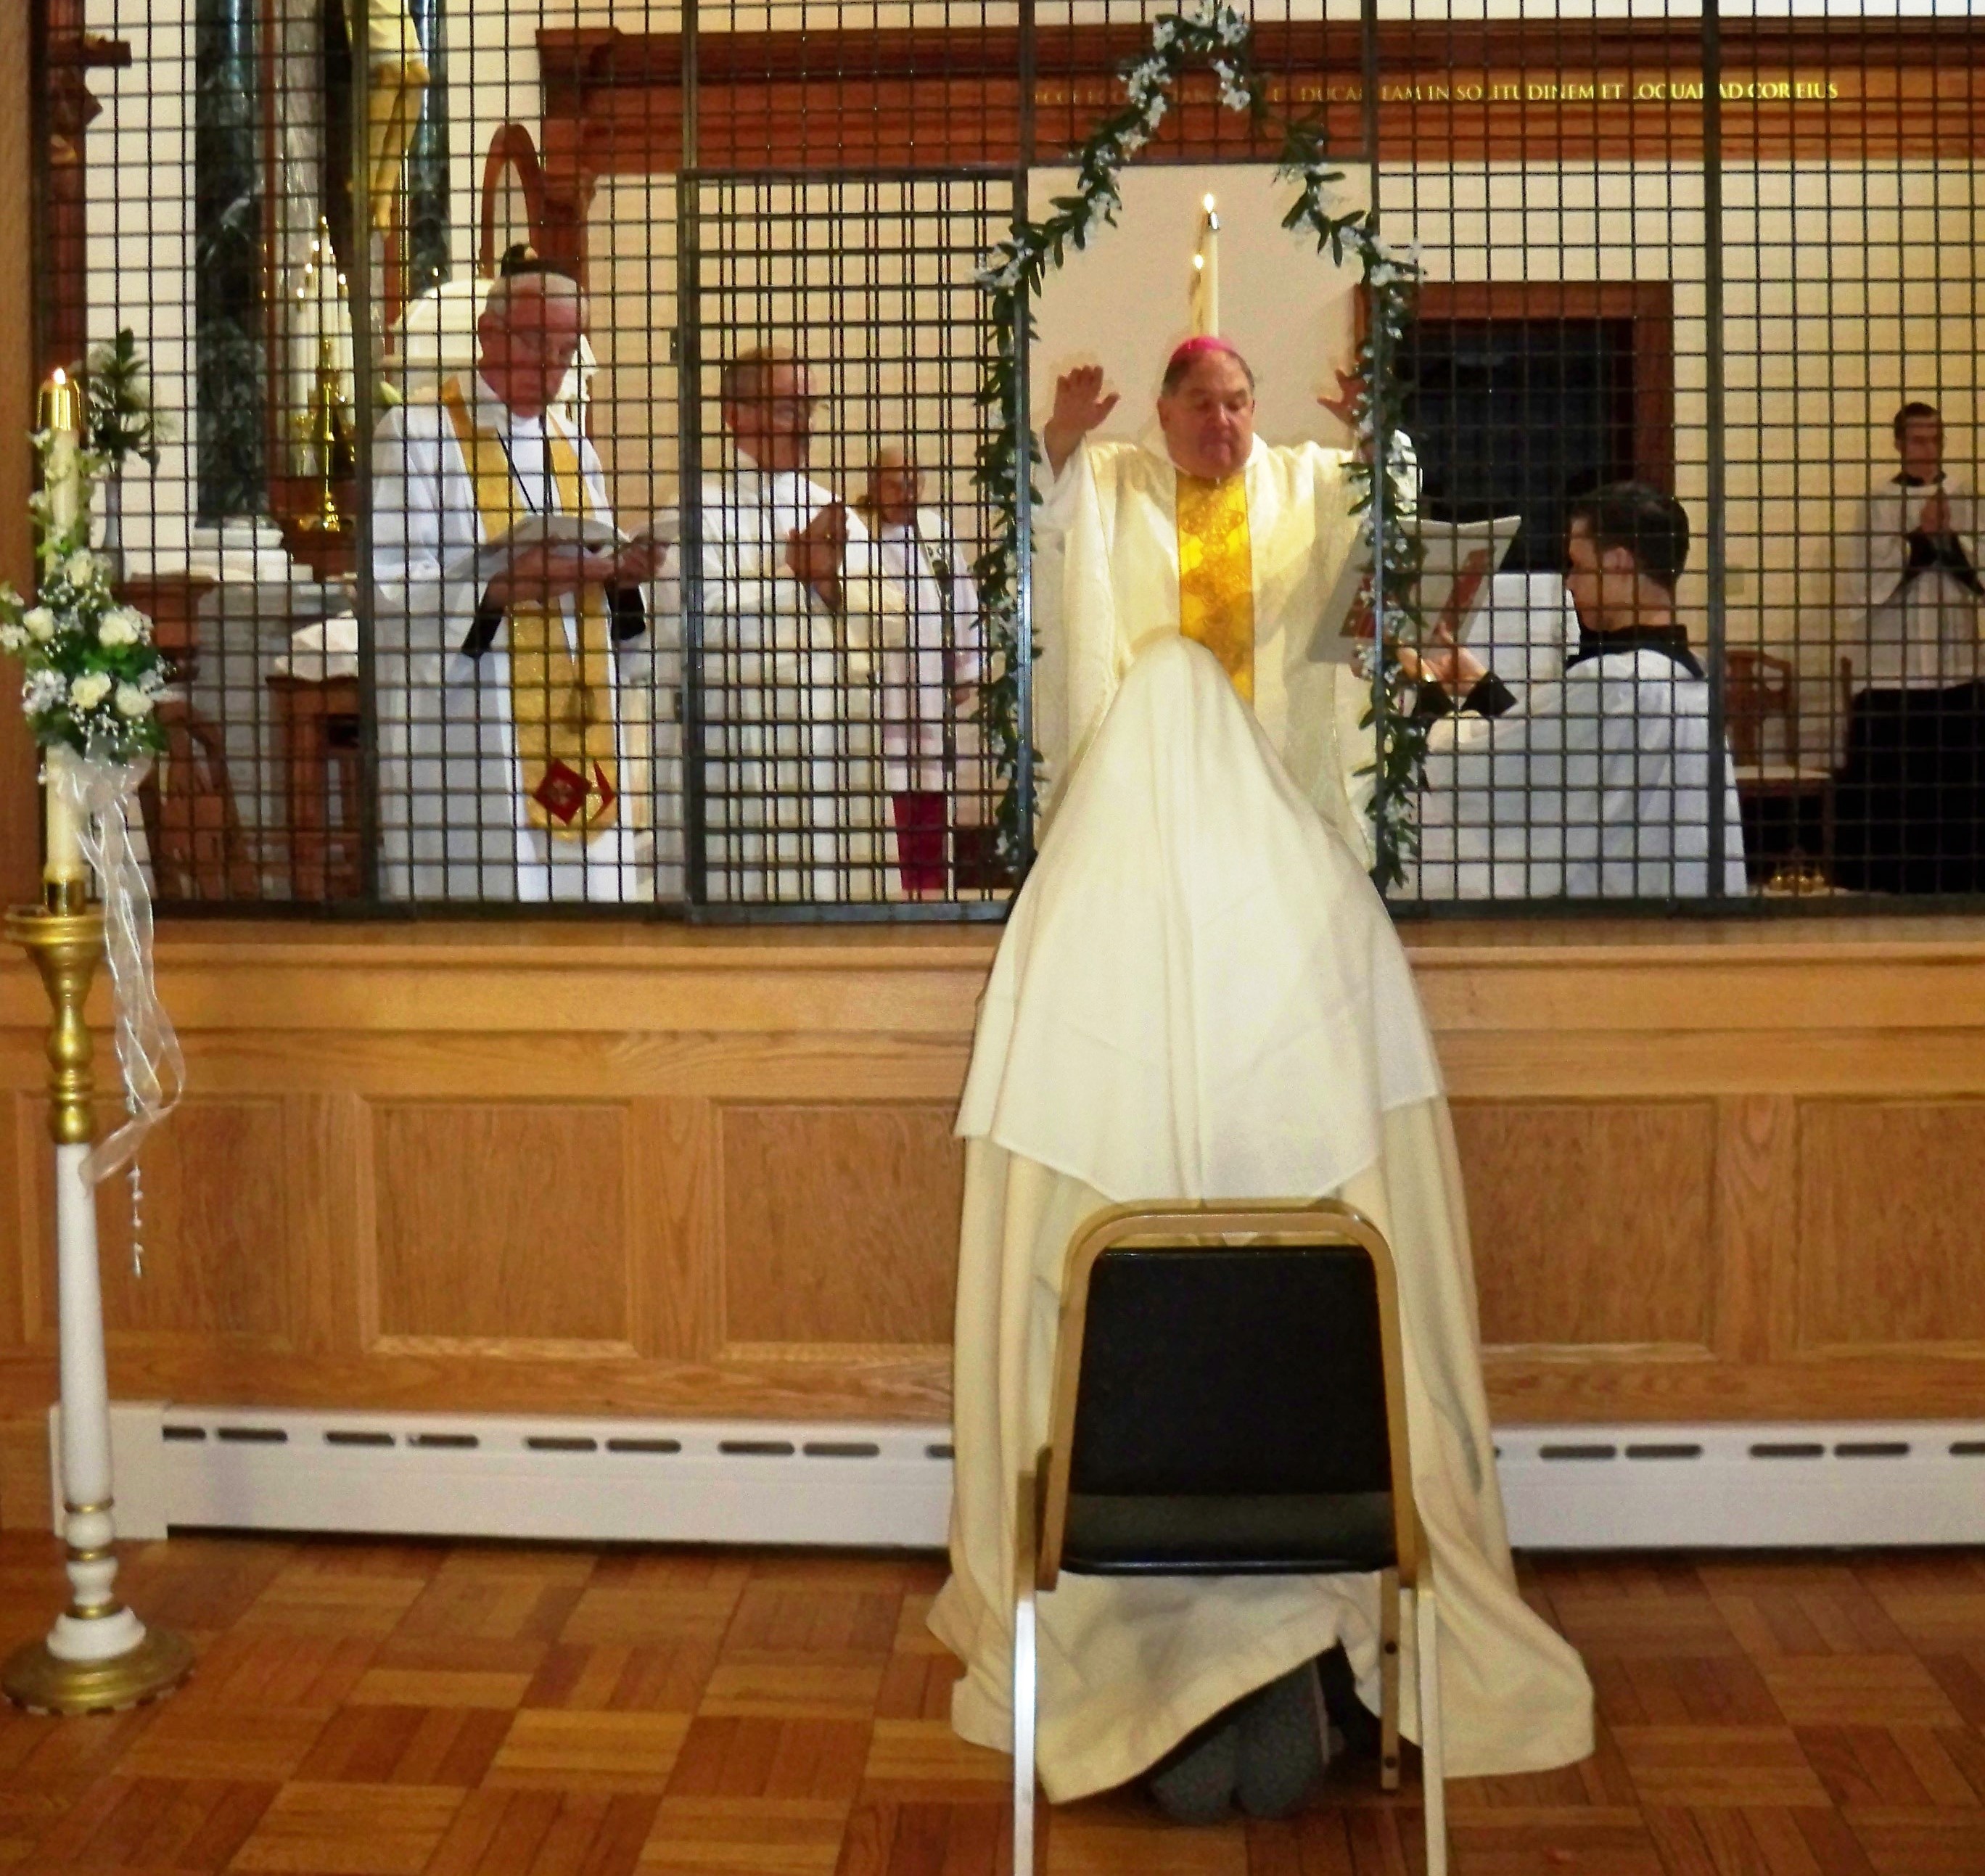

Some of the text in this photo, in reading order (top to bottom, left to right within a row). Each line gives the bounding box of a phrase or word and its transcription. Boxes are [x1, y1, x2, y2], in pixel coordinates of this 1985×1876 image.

[1428, 85, 1450, 101] IN
[1602, 83, 1624, 100] ET
[1747, 82, 1791, 99] COR
[1796, 82, 1838, 99] EIUS
